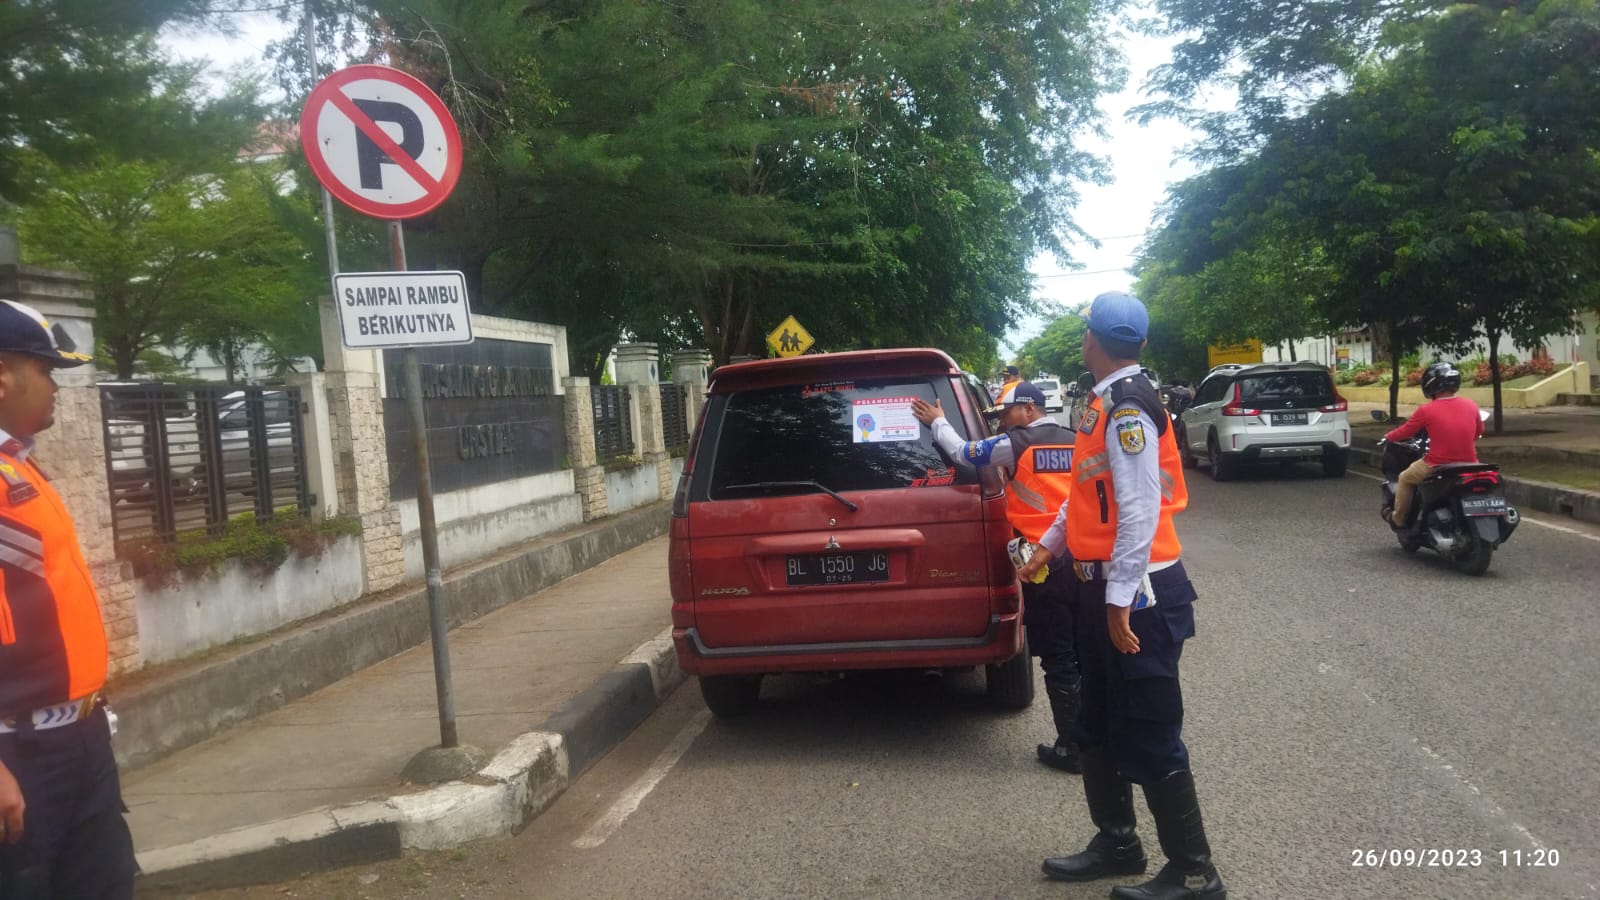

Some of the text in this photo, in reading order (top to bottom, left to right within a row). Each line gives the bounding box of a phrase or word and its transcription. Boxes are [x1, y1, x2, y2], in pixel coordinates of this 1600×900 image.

[352, 98, 424, 190] P
[345, 285, 459, 307] SAMPAI RAMBU
[358, 313, 456, 335] BERIKUTNYA
[1036, 449, 1073, 470] DISH
[788, 553, 886, 576] BL 1550 JG
